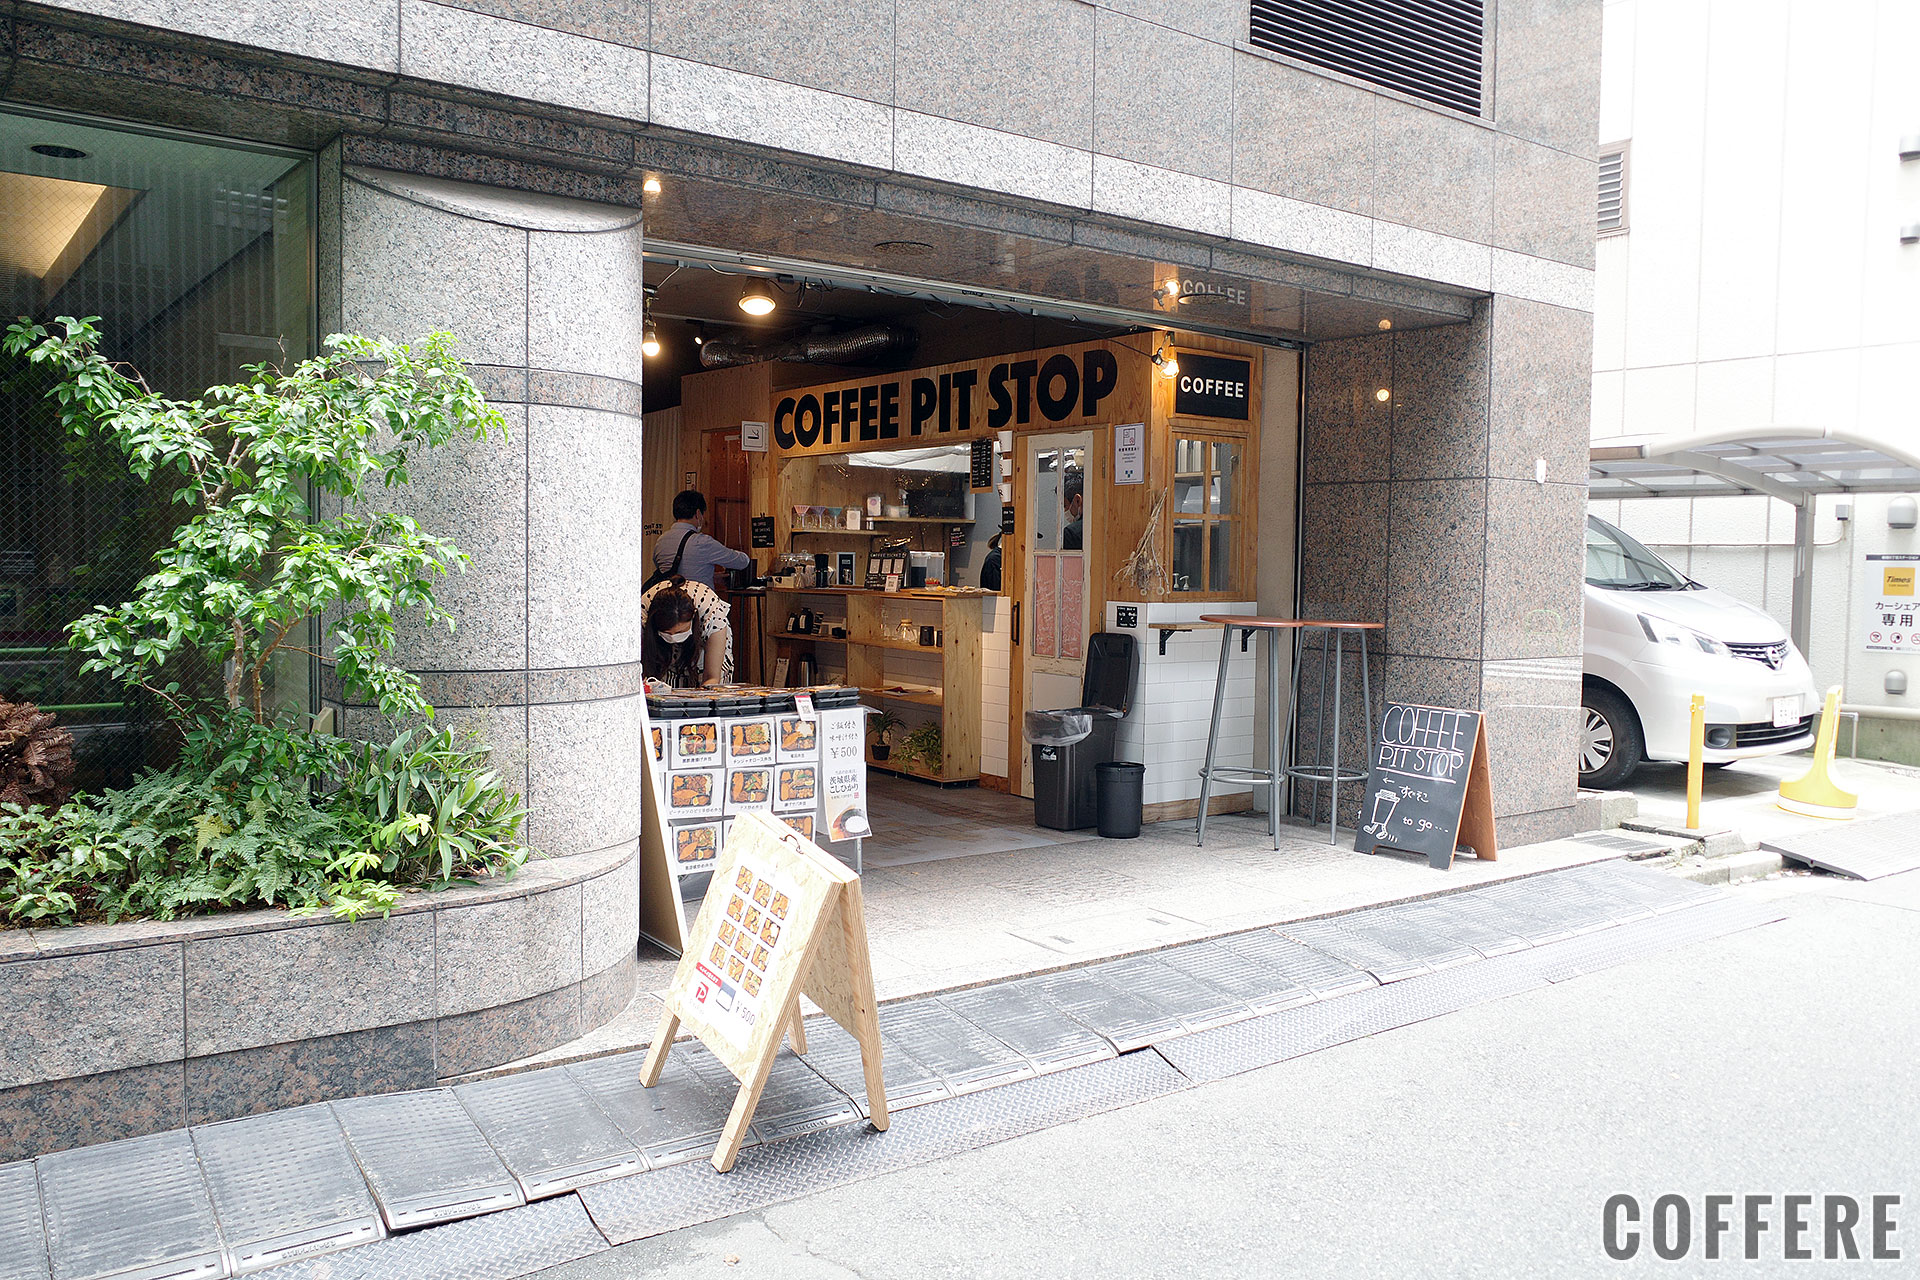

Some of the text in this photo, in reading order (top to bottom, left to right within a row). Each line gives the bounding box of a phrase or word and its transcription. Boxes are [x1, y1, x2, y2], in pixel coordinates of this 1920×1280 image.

[1180, 375, 1244, 398] COFFEE
[774, 349, 1118, 449] COFFEE PIT STOP
[1887, 575, 1911, 583] Times
[1875, 602, 1920, 611] カーシェア
[1882, 613, 1913, 627] 専用
[1382, 705, 1471, 752] COFFEE
[1378, 745, 1464, 777] PIT STOP
[829, 784, 859, 794] こしひかり
[1402, 816, 1413, 826] to
